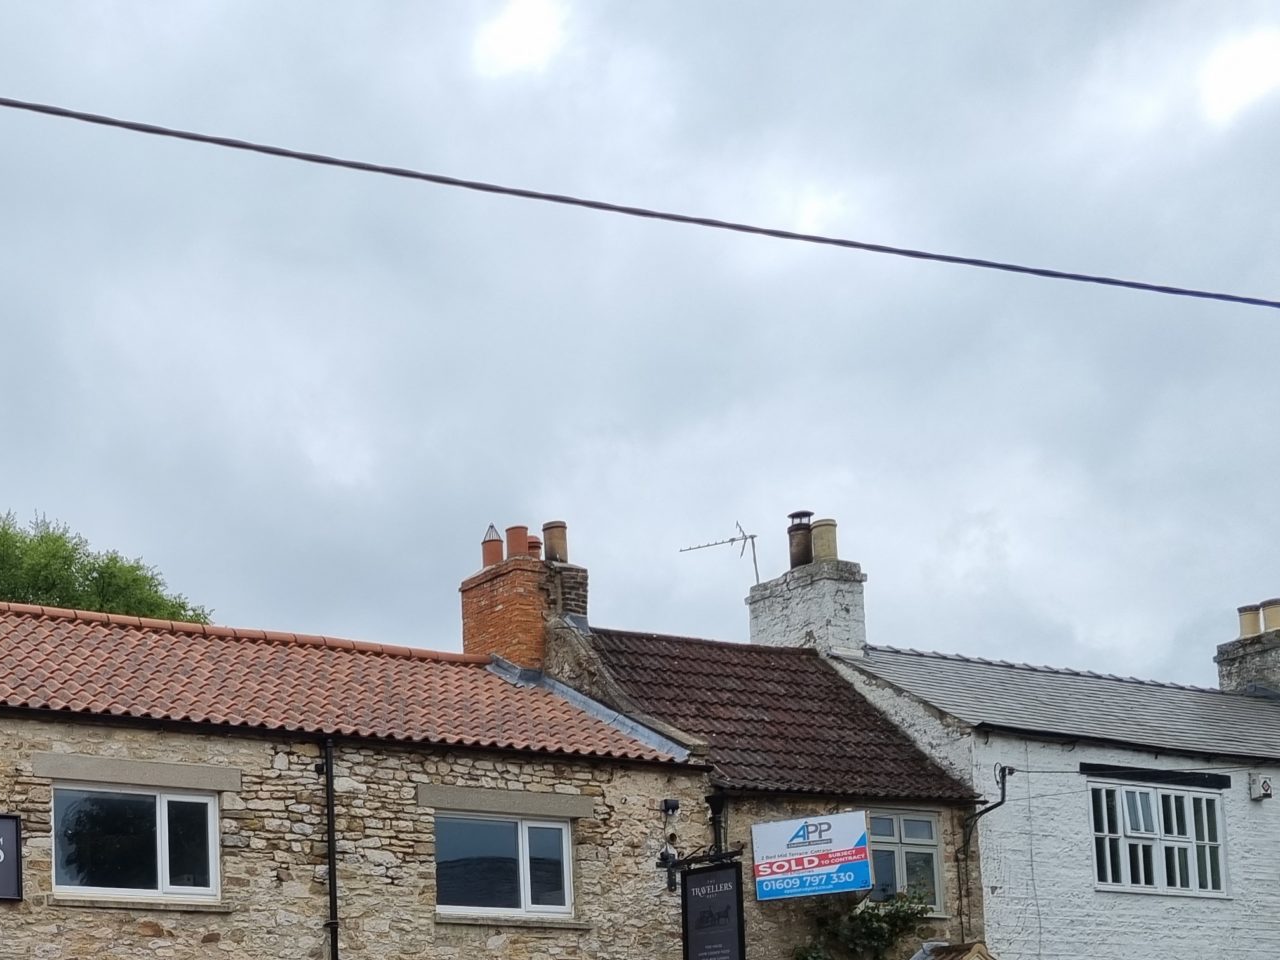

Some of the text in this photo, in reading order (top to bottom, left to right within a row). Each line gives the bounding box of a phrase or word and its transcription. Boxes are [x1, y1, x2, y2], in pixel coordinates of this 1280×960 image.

[788, 820, 832, 842] APP
[828, 849, 856, 859] SUBJECT
[830, 853, 865, 864] CONTRACT
[758, 856, 820, 875] SOLD
[691, 882, 733, 897] TRAVELLERS
[762, 872, 854, 891] 01609 797 330
